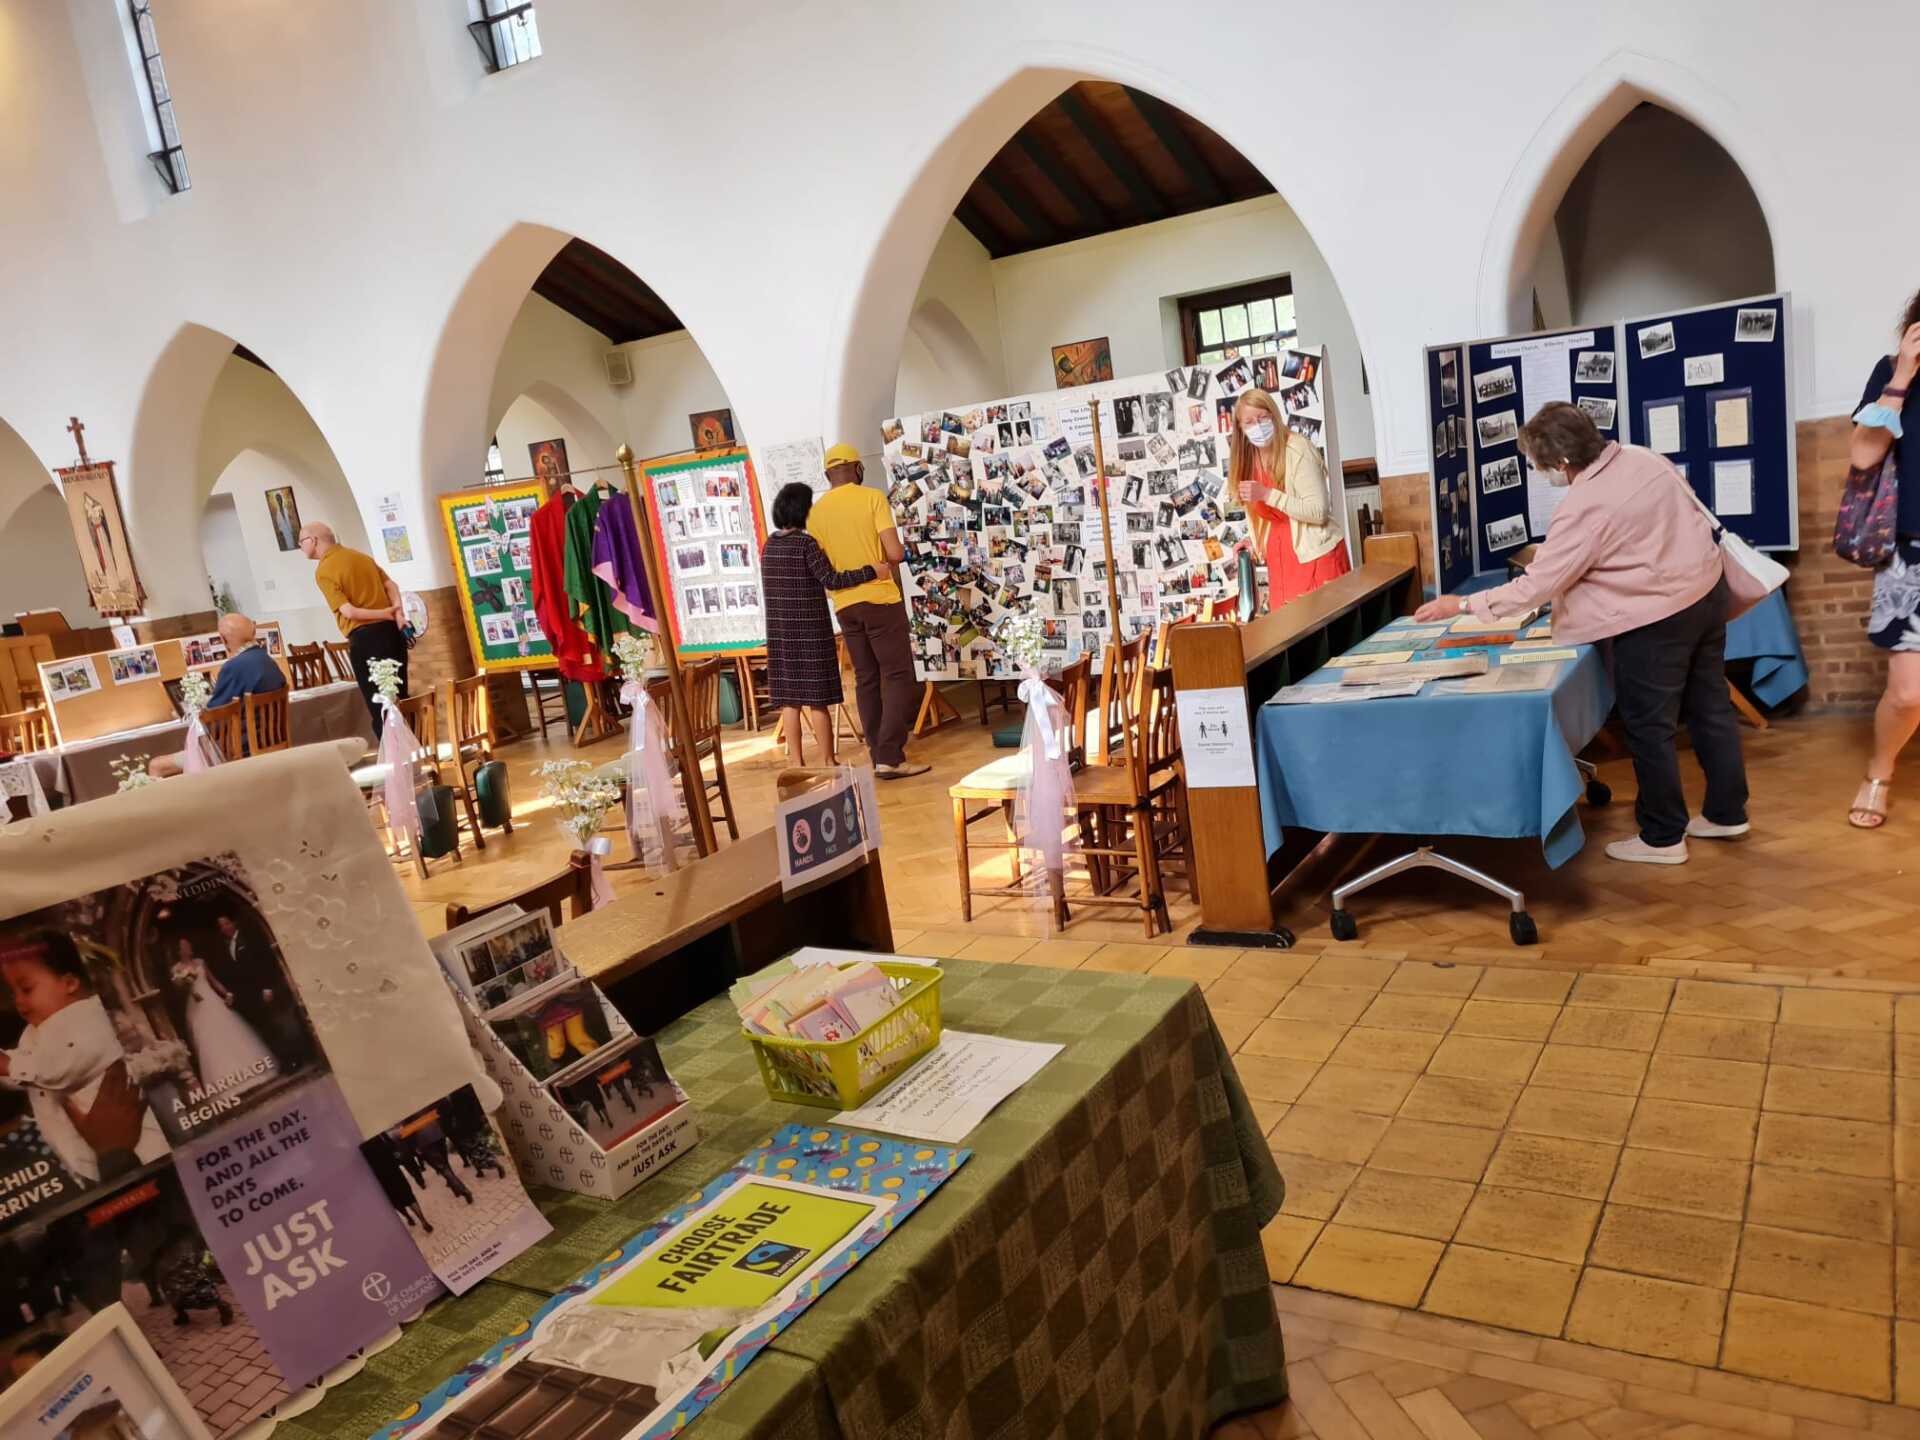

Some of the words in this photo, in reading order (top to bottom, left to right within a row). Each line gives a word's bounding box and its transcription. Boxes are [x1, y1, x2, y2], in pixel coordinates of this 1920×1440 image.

[172, 1097, 186, 1112] A
[188, 1055, 275, 1105] MARRIAGE
[179, 1095, 241, 1131] BEGINS
[196, 1145, 232, 1172] FOR
[233, 1128, 266, 1153] THE
[269, 1109, 308, 1135] DAY.
[204, 1162, 243, 1193] AND
[249, 1146, 279, 1169] ALL
[279, 1127, 312, 1151] THE
[633, 1153, 655, 1177] JUST
[658, 1140, 677, 1160] ASK
[211, 1177, 257, 1210] DAYS
[217, 1208, 244, 1229] TO
[248, 1177, 305, 1213] COME.
[243, 1199, 335, 1276] JUST
[656, 1201, 791, 1294] FAIRTRADE
[658, 1214, 737, 1264] CHOOSE
[263, 1237, 349, 1311] ASK
[38, 1374, 93, 1425] TWINNED
